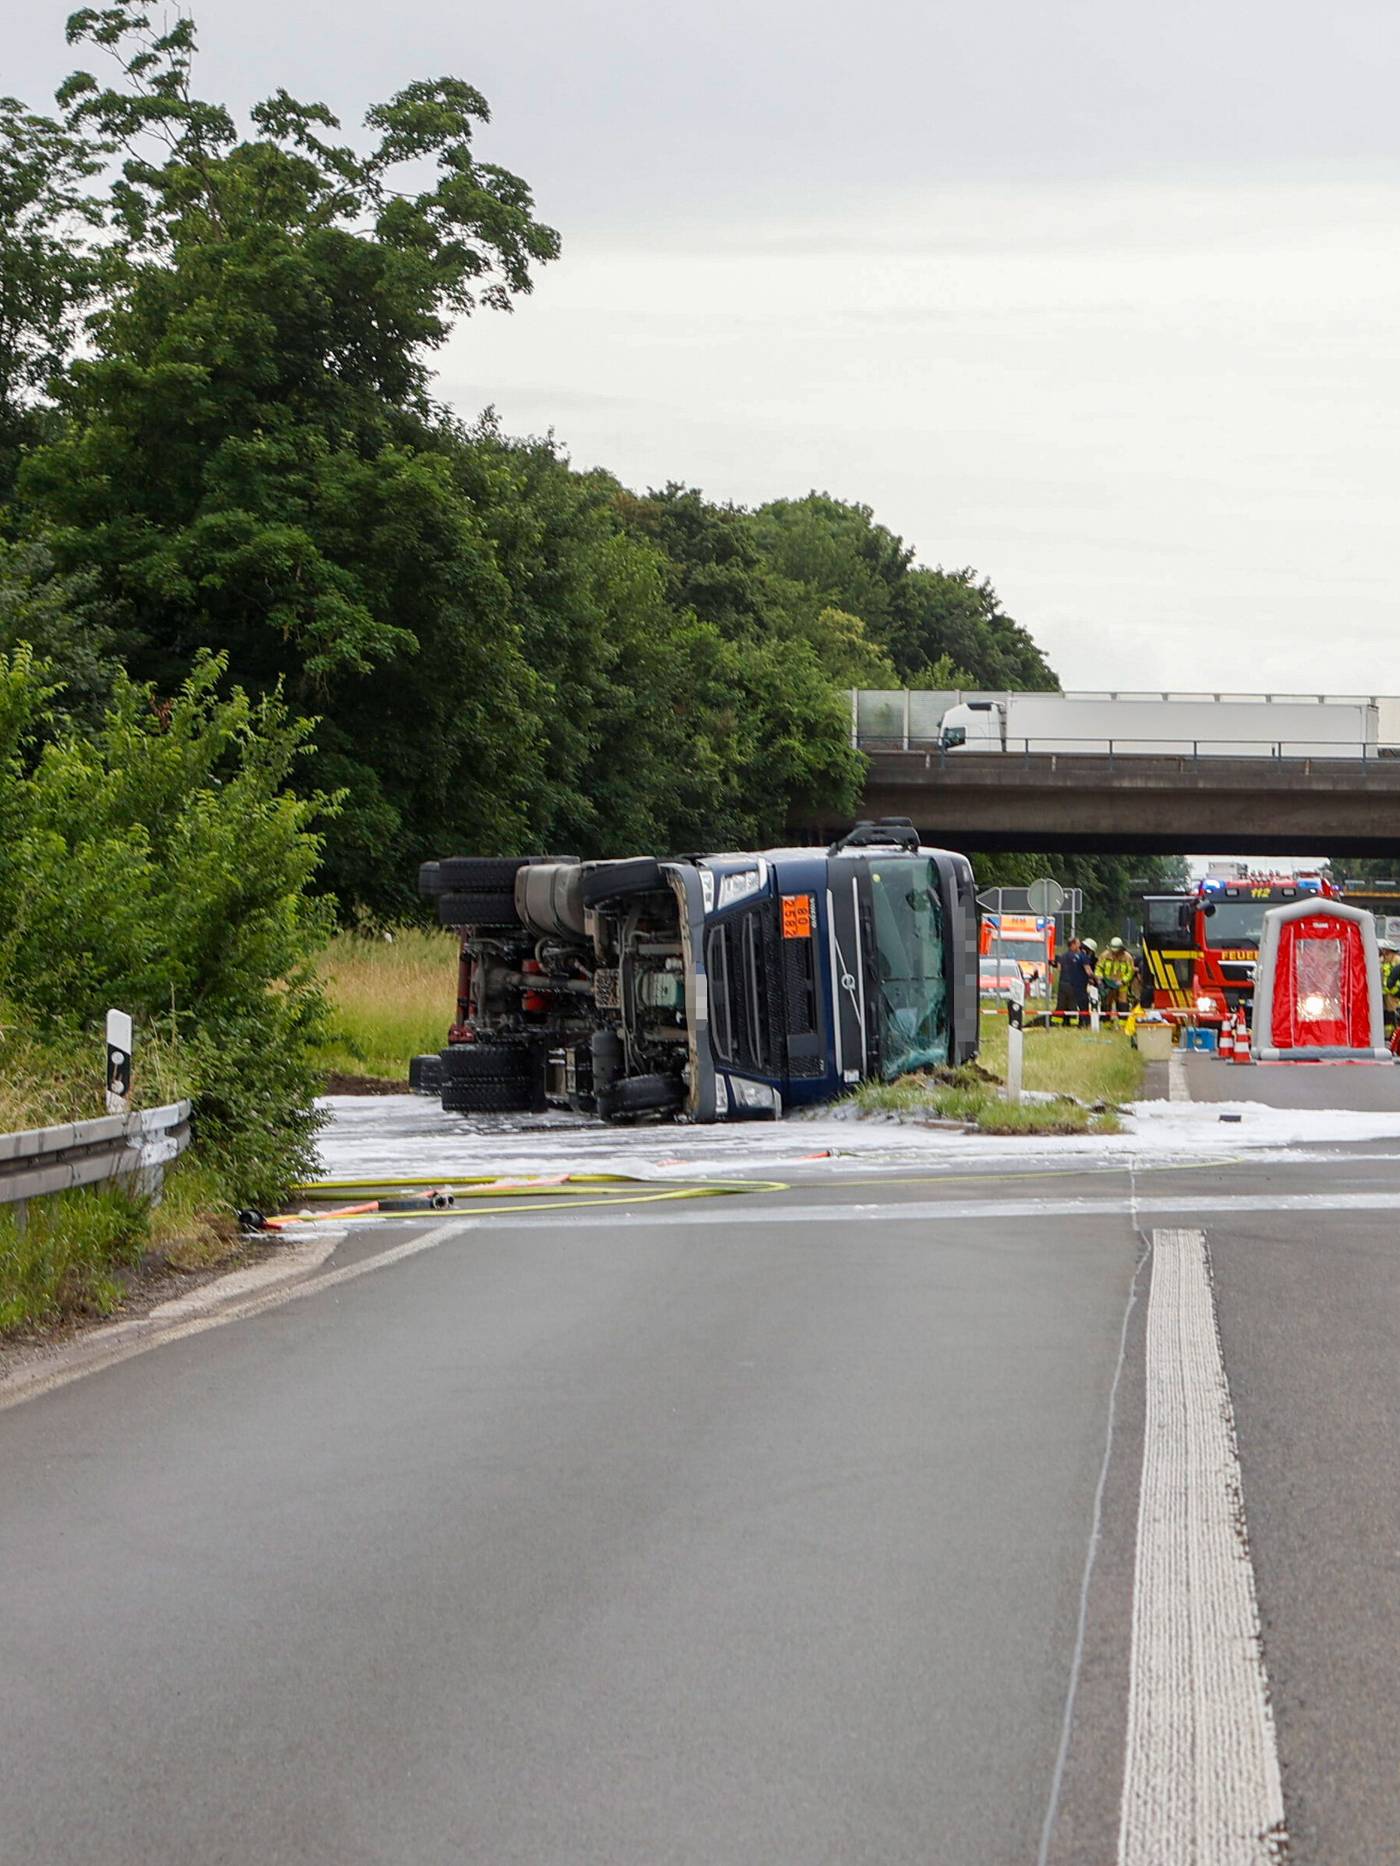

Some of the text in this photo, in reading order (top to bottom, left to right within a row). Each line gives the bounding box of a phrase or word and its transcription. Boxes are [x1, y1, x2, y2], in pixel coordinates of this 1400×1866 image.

[1250, 887, 1272, 899] 112
[784, 900, 798, 937] 2582
[797, 908, 809, 925] 80
